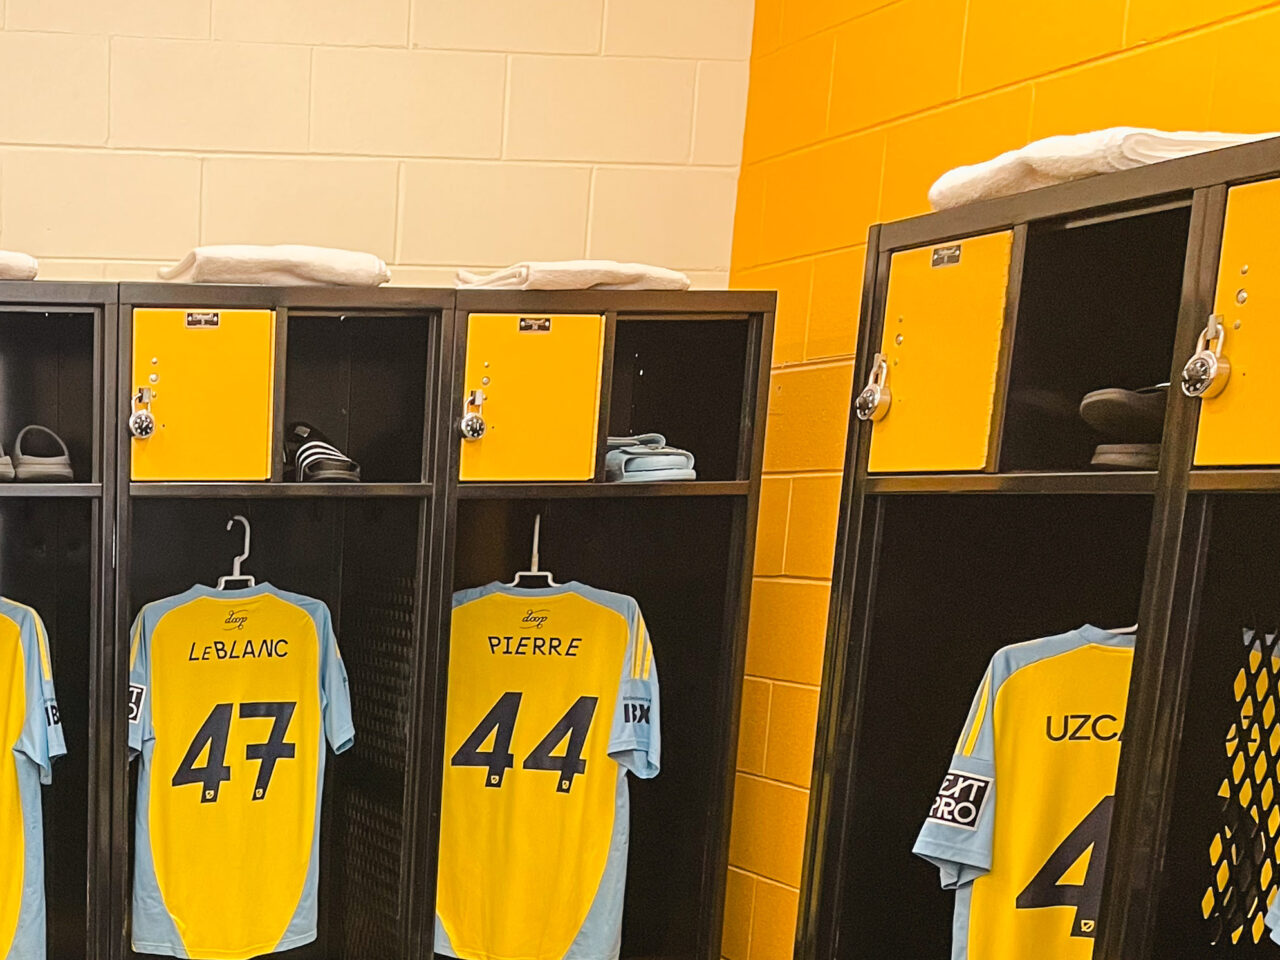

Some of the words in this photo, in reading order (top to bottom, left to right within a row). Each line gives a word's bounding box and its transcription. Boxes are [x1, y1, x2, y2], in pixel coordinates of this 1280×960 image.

[487, 636, 583, 657] PIERRE
[171, 701, 297, 804] 47
[450, 691, 599, 794] 44
[1046, 713, 1123, 741] UZC
